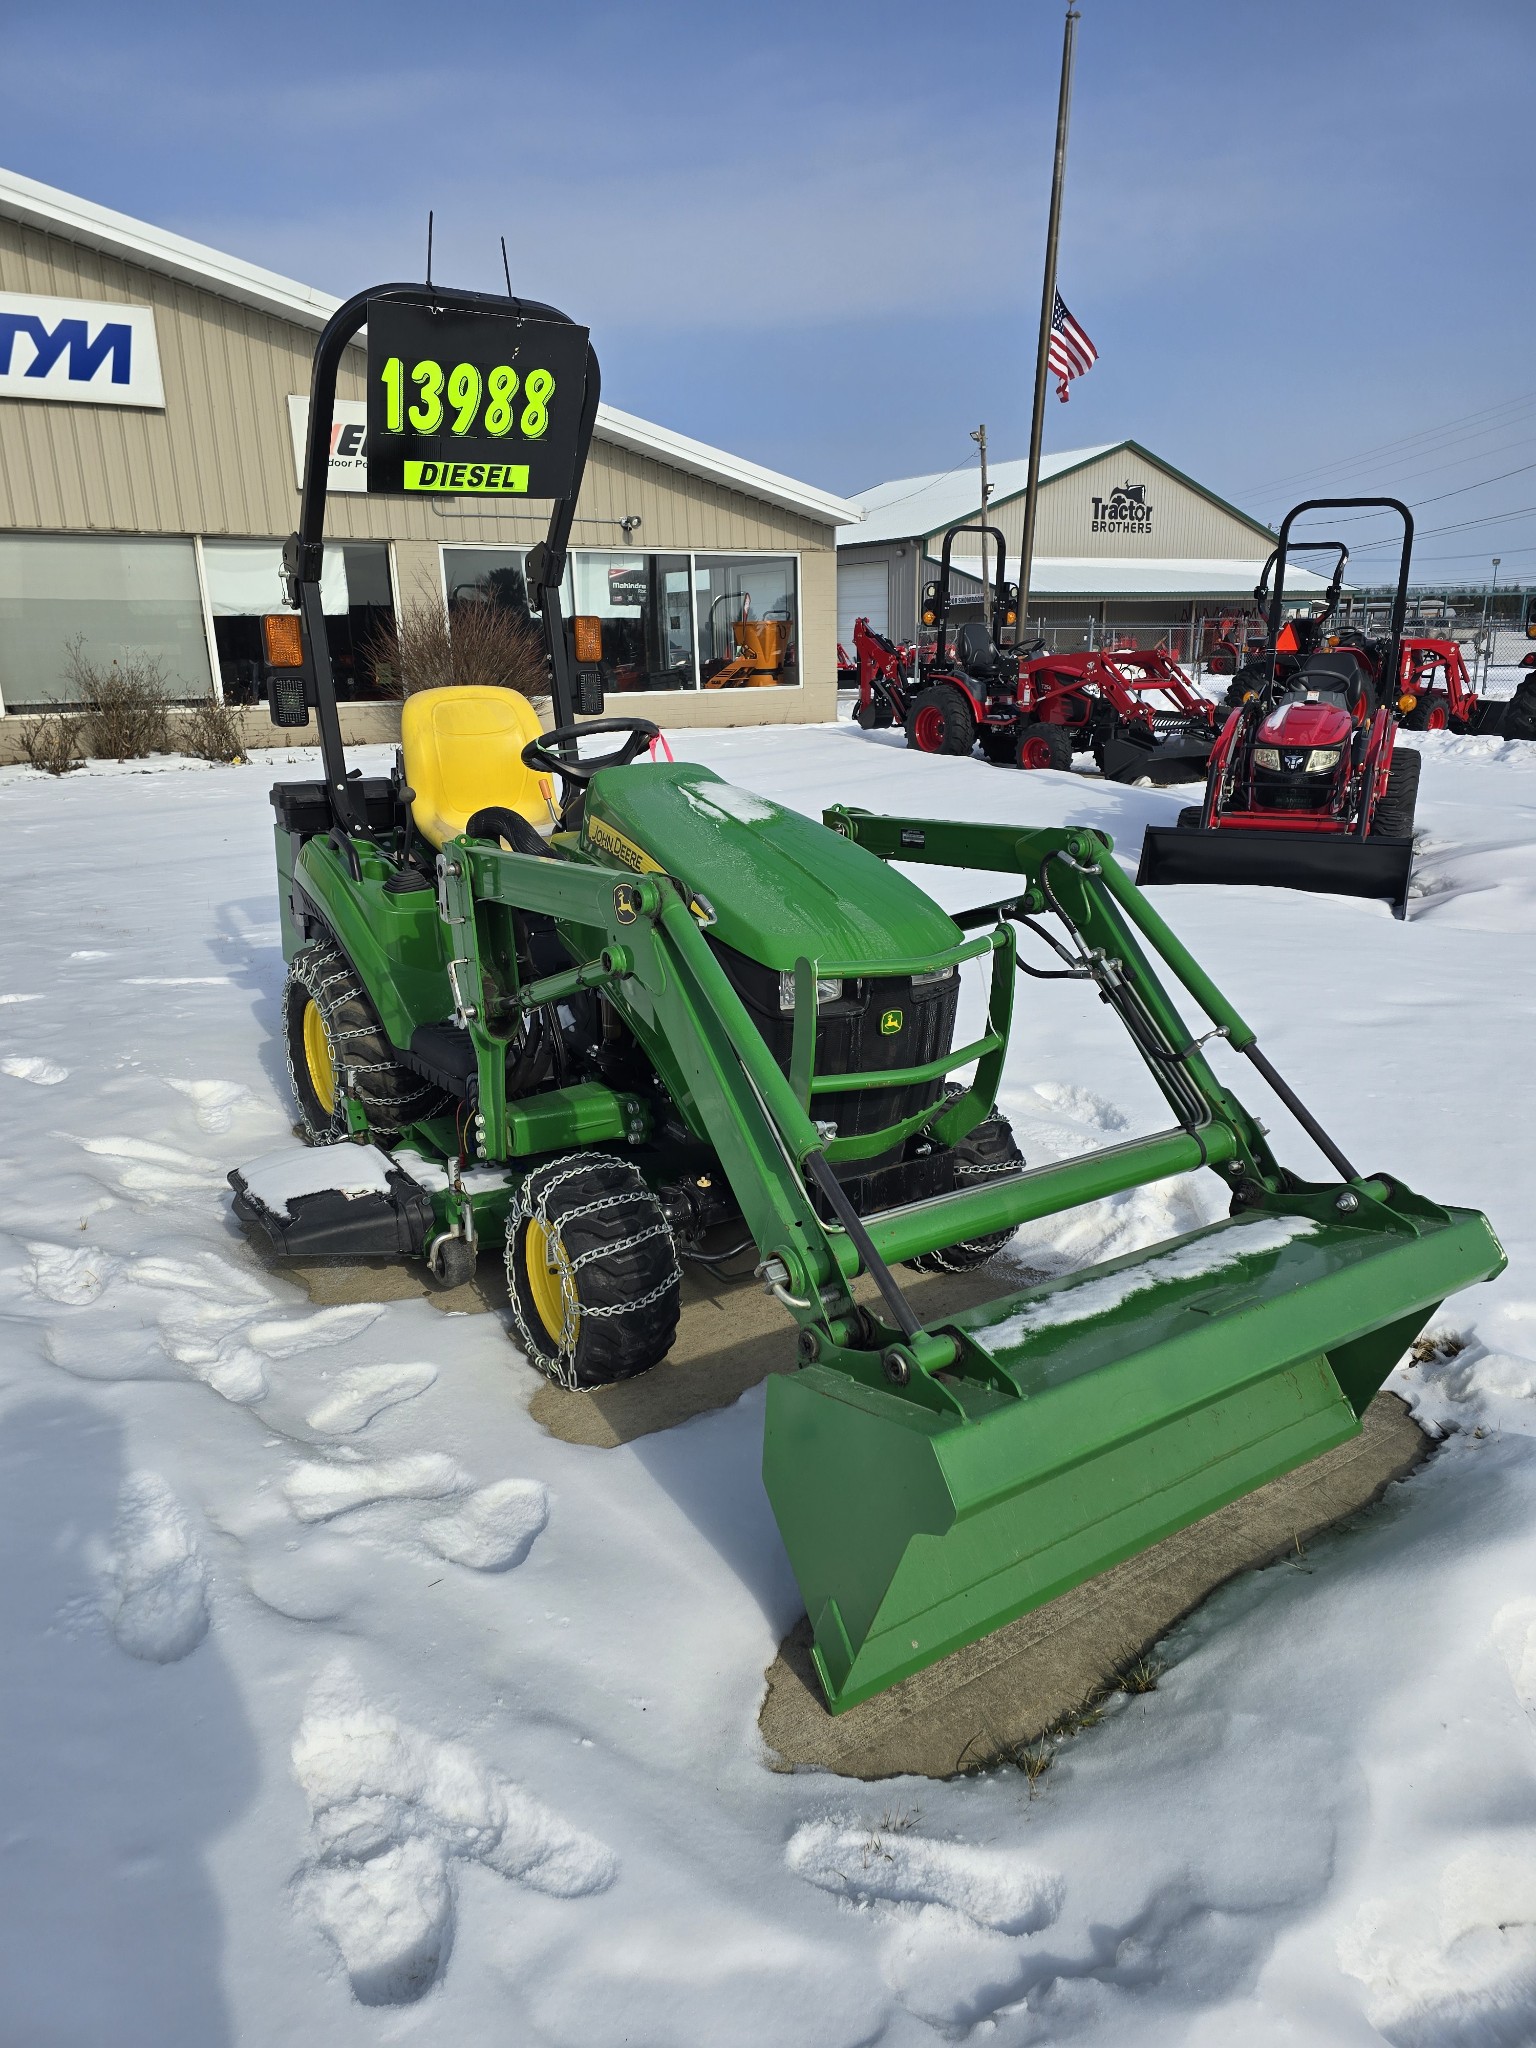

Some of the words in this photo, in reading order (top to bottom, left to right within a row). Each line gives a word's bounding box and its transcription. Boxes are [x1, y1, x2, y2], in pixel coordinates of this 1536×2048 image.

[381, 357, 556, 439] 13988
[419, 463, 514, 488] DIESEL
[1092, 497, 1153, 522] Tractor
[1092, 521, 1152, 533] BROTHERS
[592, 826, 613, 852] JOHN
[614, 837, 643, 869] DEERE
